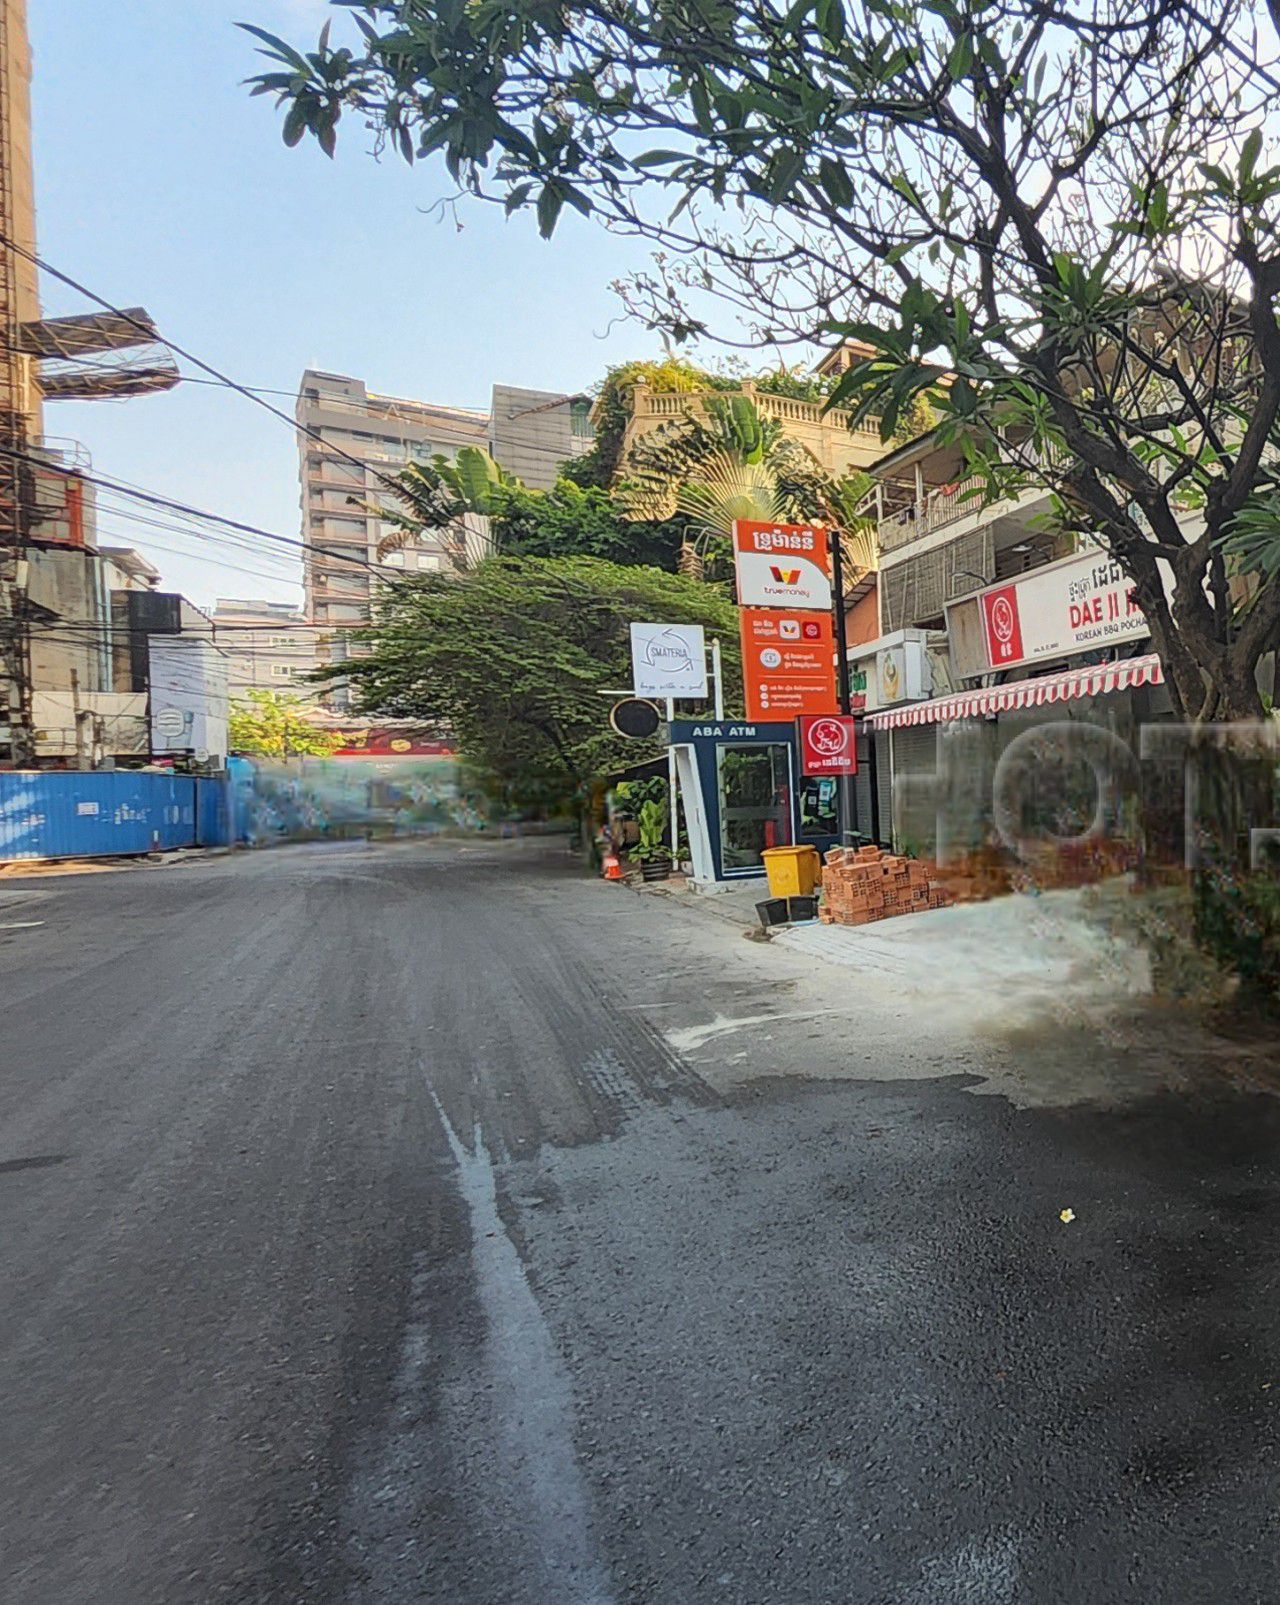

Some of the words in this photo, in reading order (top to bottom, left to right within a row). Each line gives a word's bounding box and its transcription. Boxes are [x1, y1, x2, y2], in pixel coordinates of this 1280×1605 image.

[1069, 597, 1103, 629] DAE
[1075, 629, 1102, 642] KOREAN
[1104, 624, 1120, 635] BBQ
[651, 646, 688, 658] SMATERIA
[692, 726, 723, 737] ABA
[728, 726, 757, 737] ATM
